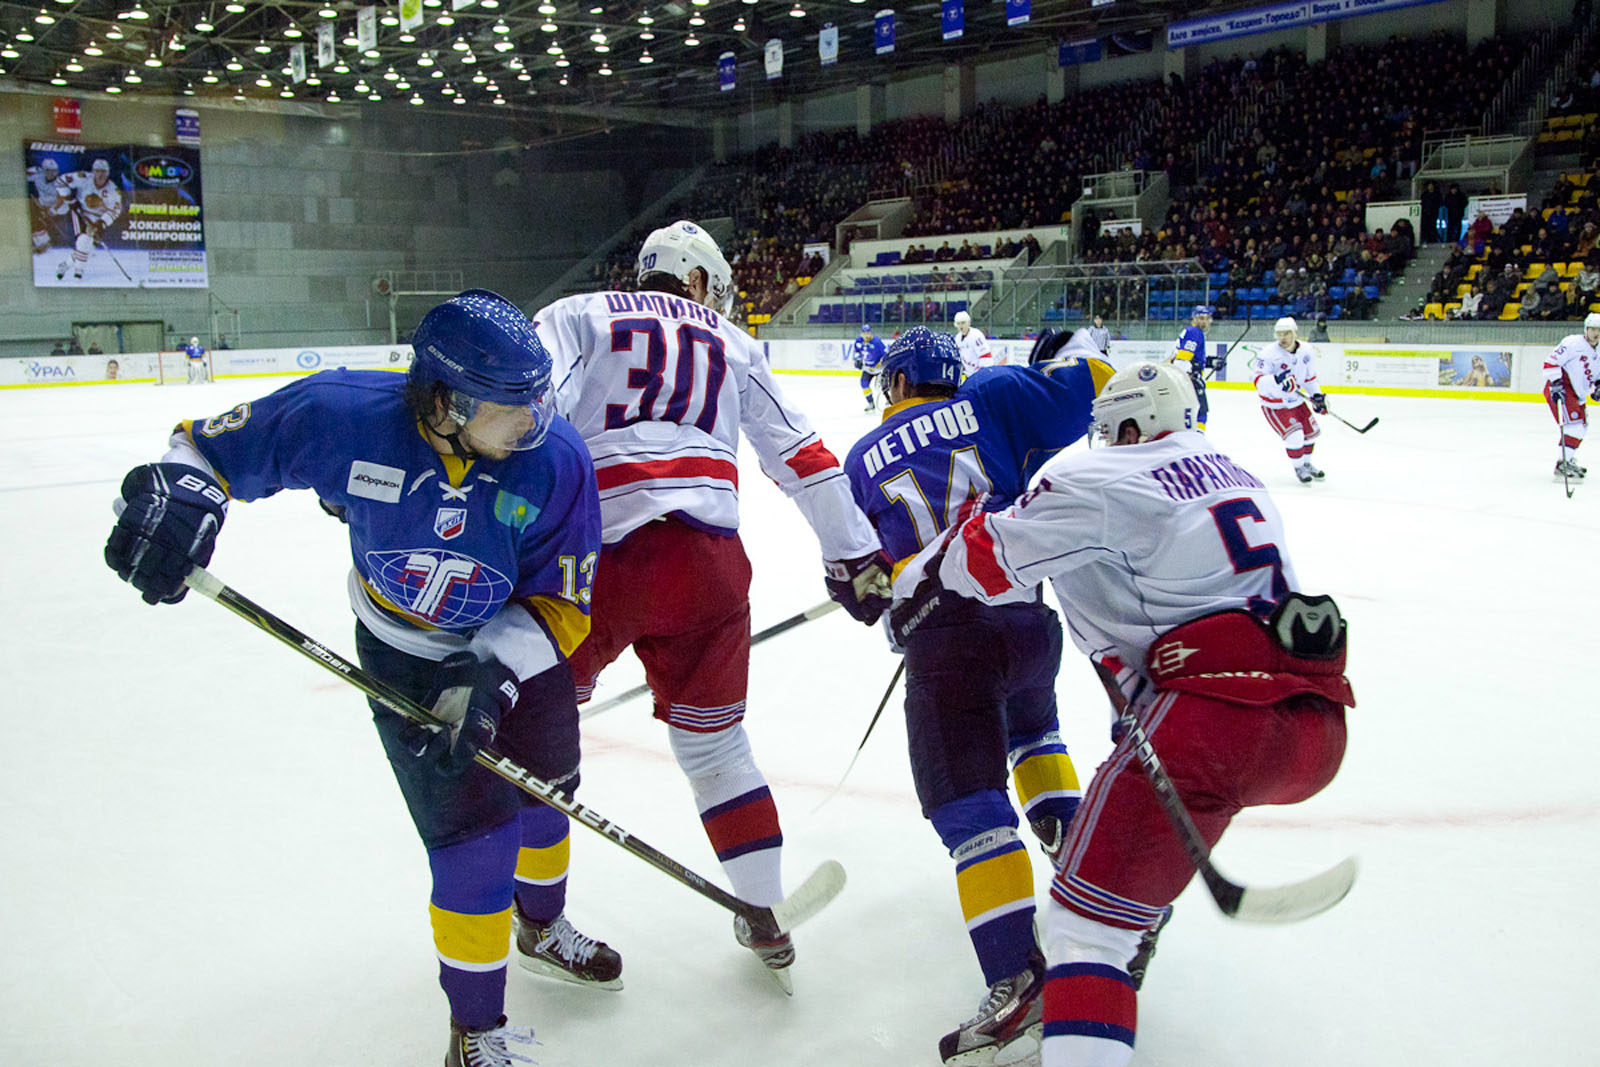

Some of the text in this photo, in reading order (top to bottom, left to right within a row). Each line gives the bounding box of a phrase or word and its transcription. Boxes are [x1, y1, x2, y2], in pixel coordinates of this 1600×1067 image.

[30, 142, 86, 154] BAUER
[121, 231, 202, 242] ЭКИПИРОВКИ
[129, 219, 201, 231] ХОККЕЙНОЙ
[640, 252, 657, 272] 30
[604, 293, 719, 329] ШИПИЛО
[427, 345, 464, 373] BAUER
[942, 362, 954, 381] 14
[604, 317, 727, 435] 30
[1183, 407, 1192, 429] 5
[862, 399, 980, 479] ПЕТРОВ
[1206, 497, 1291, 618] 5
[558, 551, 598, 604] 13
[901, 595, 941, 637] BAUER
[495, 756, 630, 843] BAUER
[684, 869, 706, 889] ONE
